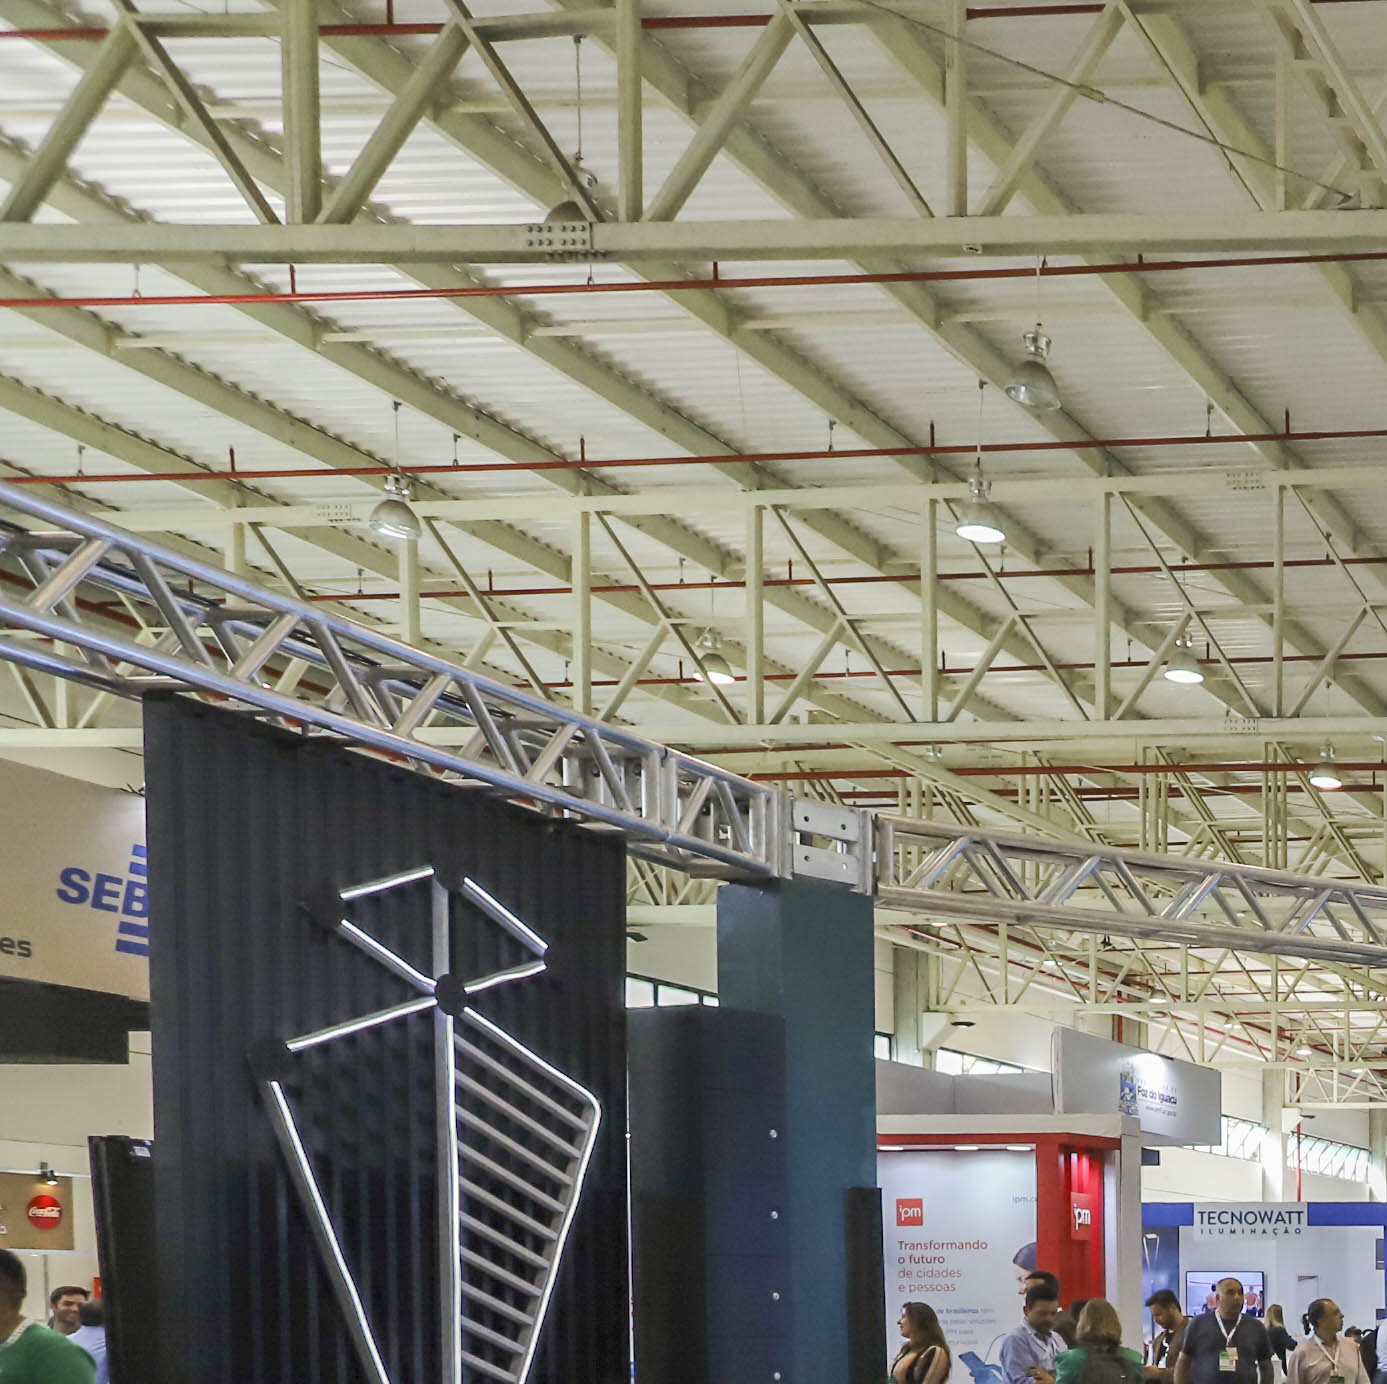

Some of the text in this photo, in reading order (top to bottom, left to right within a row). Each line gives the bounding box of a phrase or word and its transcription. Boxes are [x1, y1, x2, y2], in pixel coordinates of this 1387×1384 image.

[899, 1205, 922, 1221] ipm
[1073, 1203, 1091, 1231] ipm
[1198, 1210, 1304, 1225] TECNOWATT
[1200, 1226, 1302, 1236] ILUMINAÇÃO
[897, 1240, 988, 1251] Transformando
[897, 1255, 945, 1265] o futuro
[897, 1267, 962, 1279] de cidades
[897, 1283, 956, 1294] e pessoas
